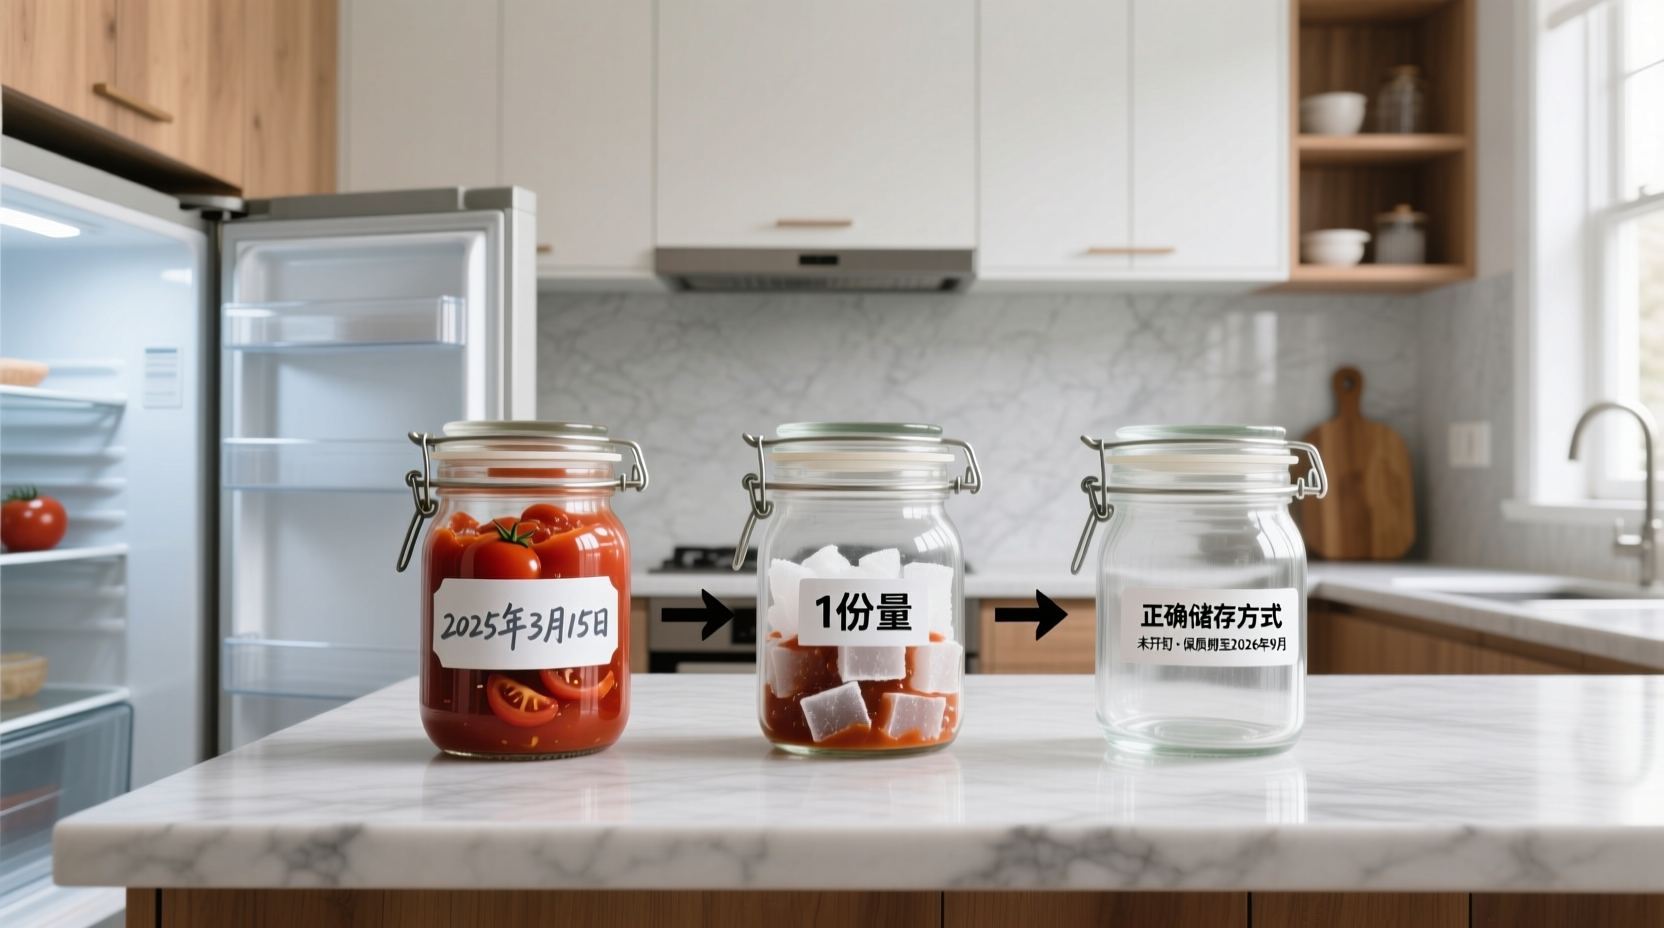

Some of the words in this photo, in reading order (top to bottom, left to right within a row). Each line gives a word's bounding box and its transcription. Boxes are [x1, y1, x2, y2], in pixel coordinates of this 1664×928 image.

[440, 602, 609, 651] 2025年3月15日
[815, 591, 912, 632] 1份量
[1140, 602, 1283, 630] 正确储存方式
